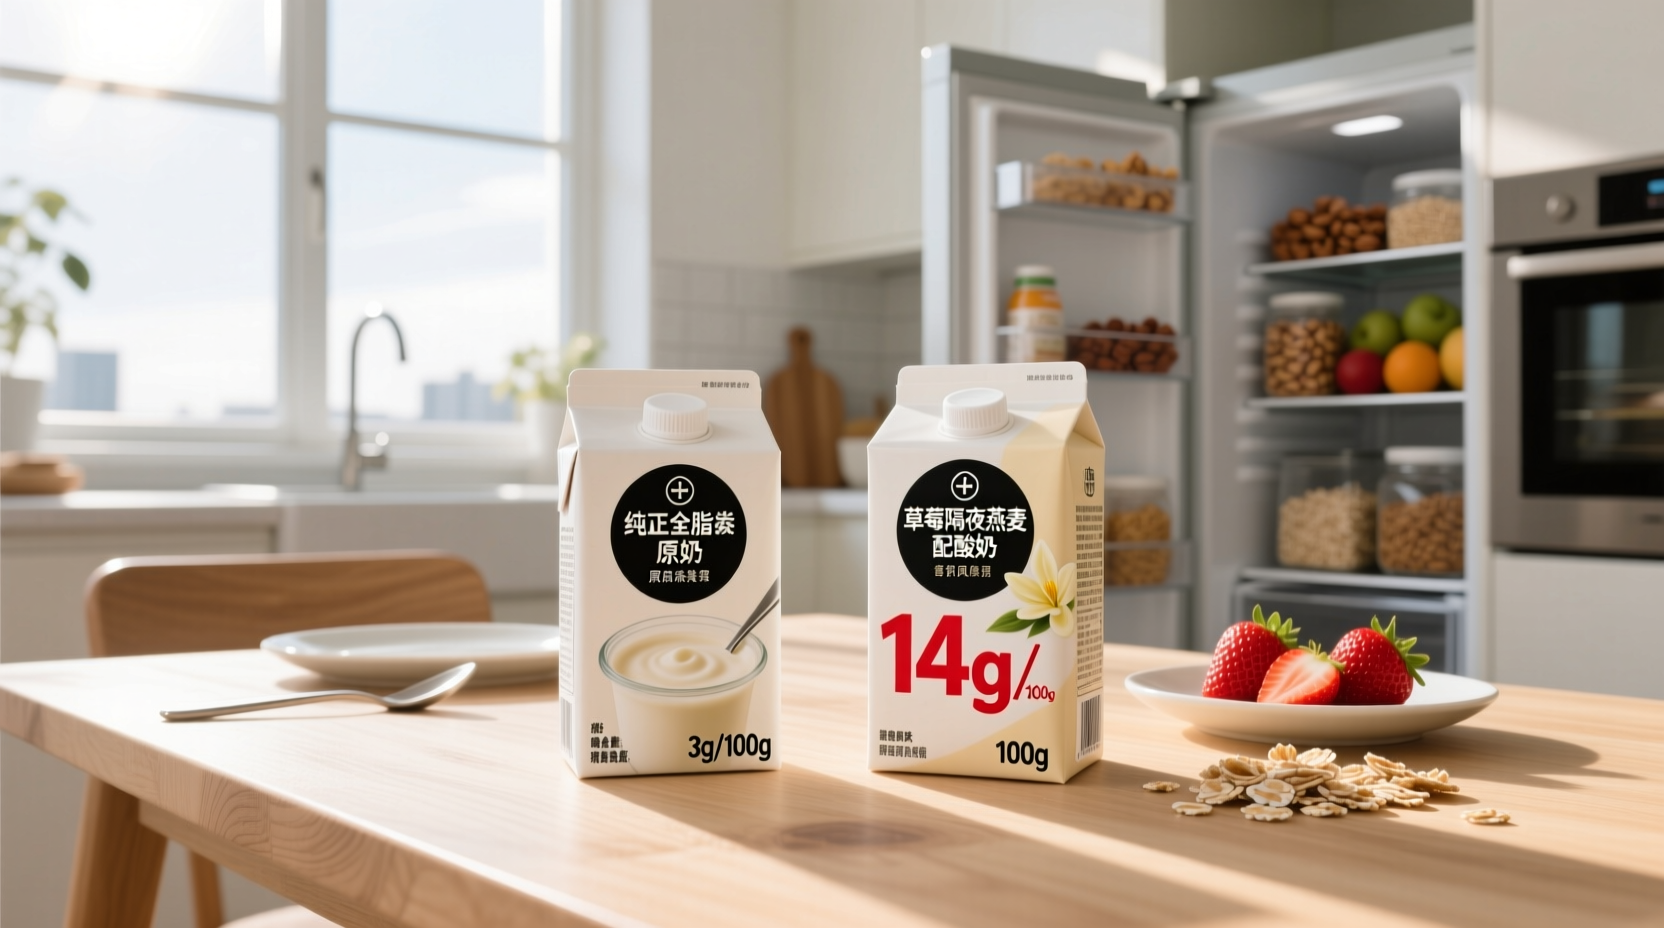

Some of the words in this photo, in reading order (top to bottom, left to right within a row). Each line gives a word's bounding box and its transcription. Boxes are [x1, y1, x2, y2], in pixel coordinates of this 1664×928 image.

[903, 506, 1027, 532] 草莓隔夜燕麦
[656, 539, 703, 565] 原奶
[932, 533, 997, 558] 配酸奶
[688, 733, 772, 764] 3g/100g
[995, 740, 1049, 772] 100g
